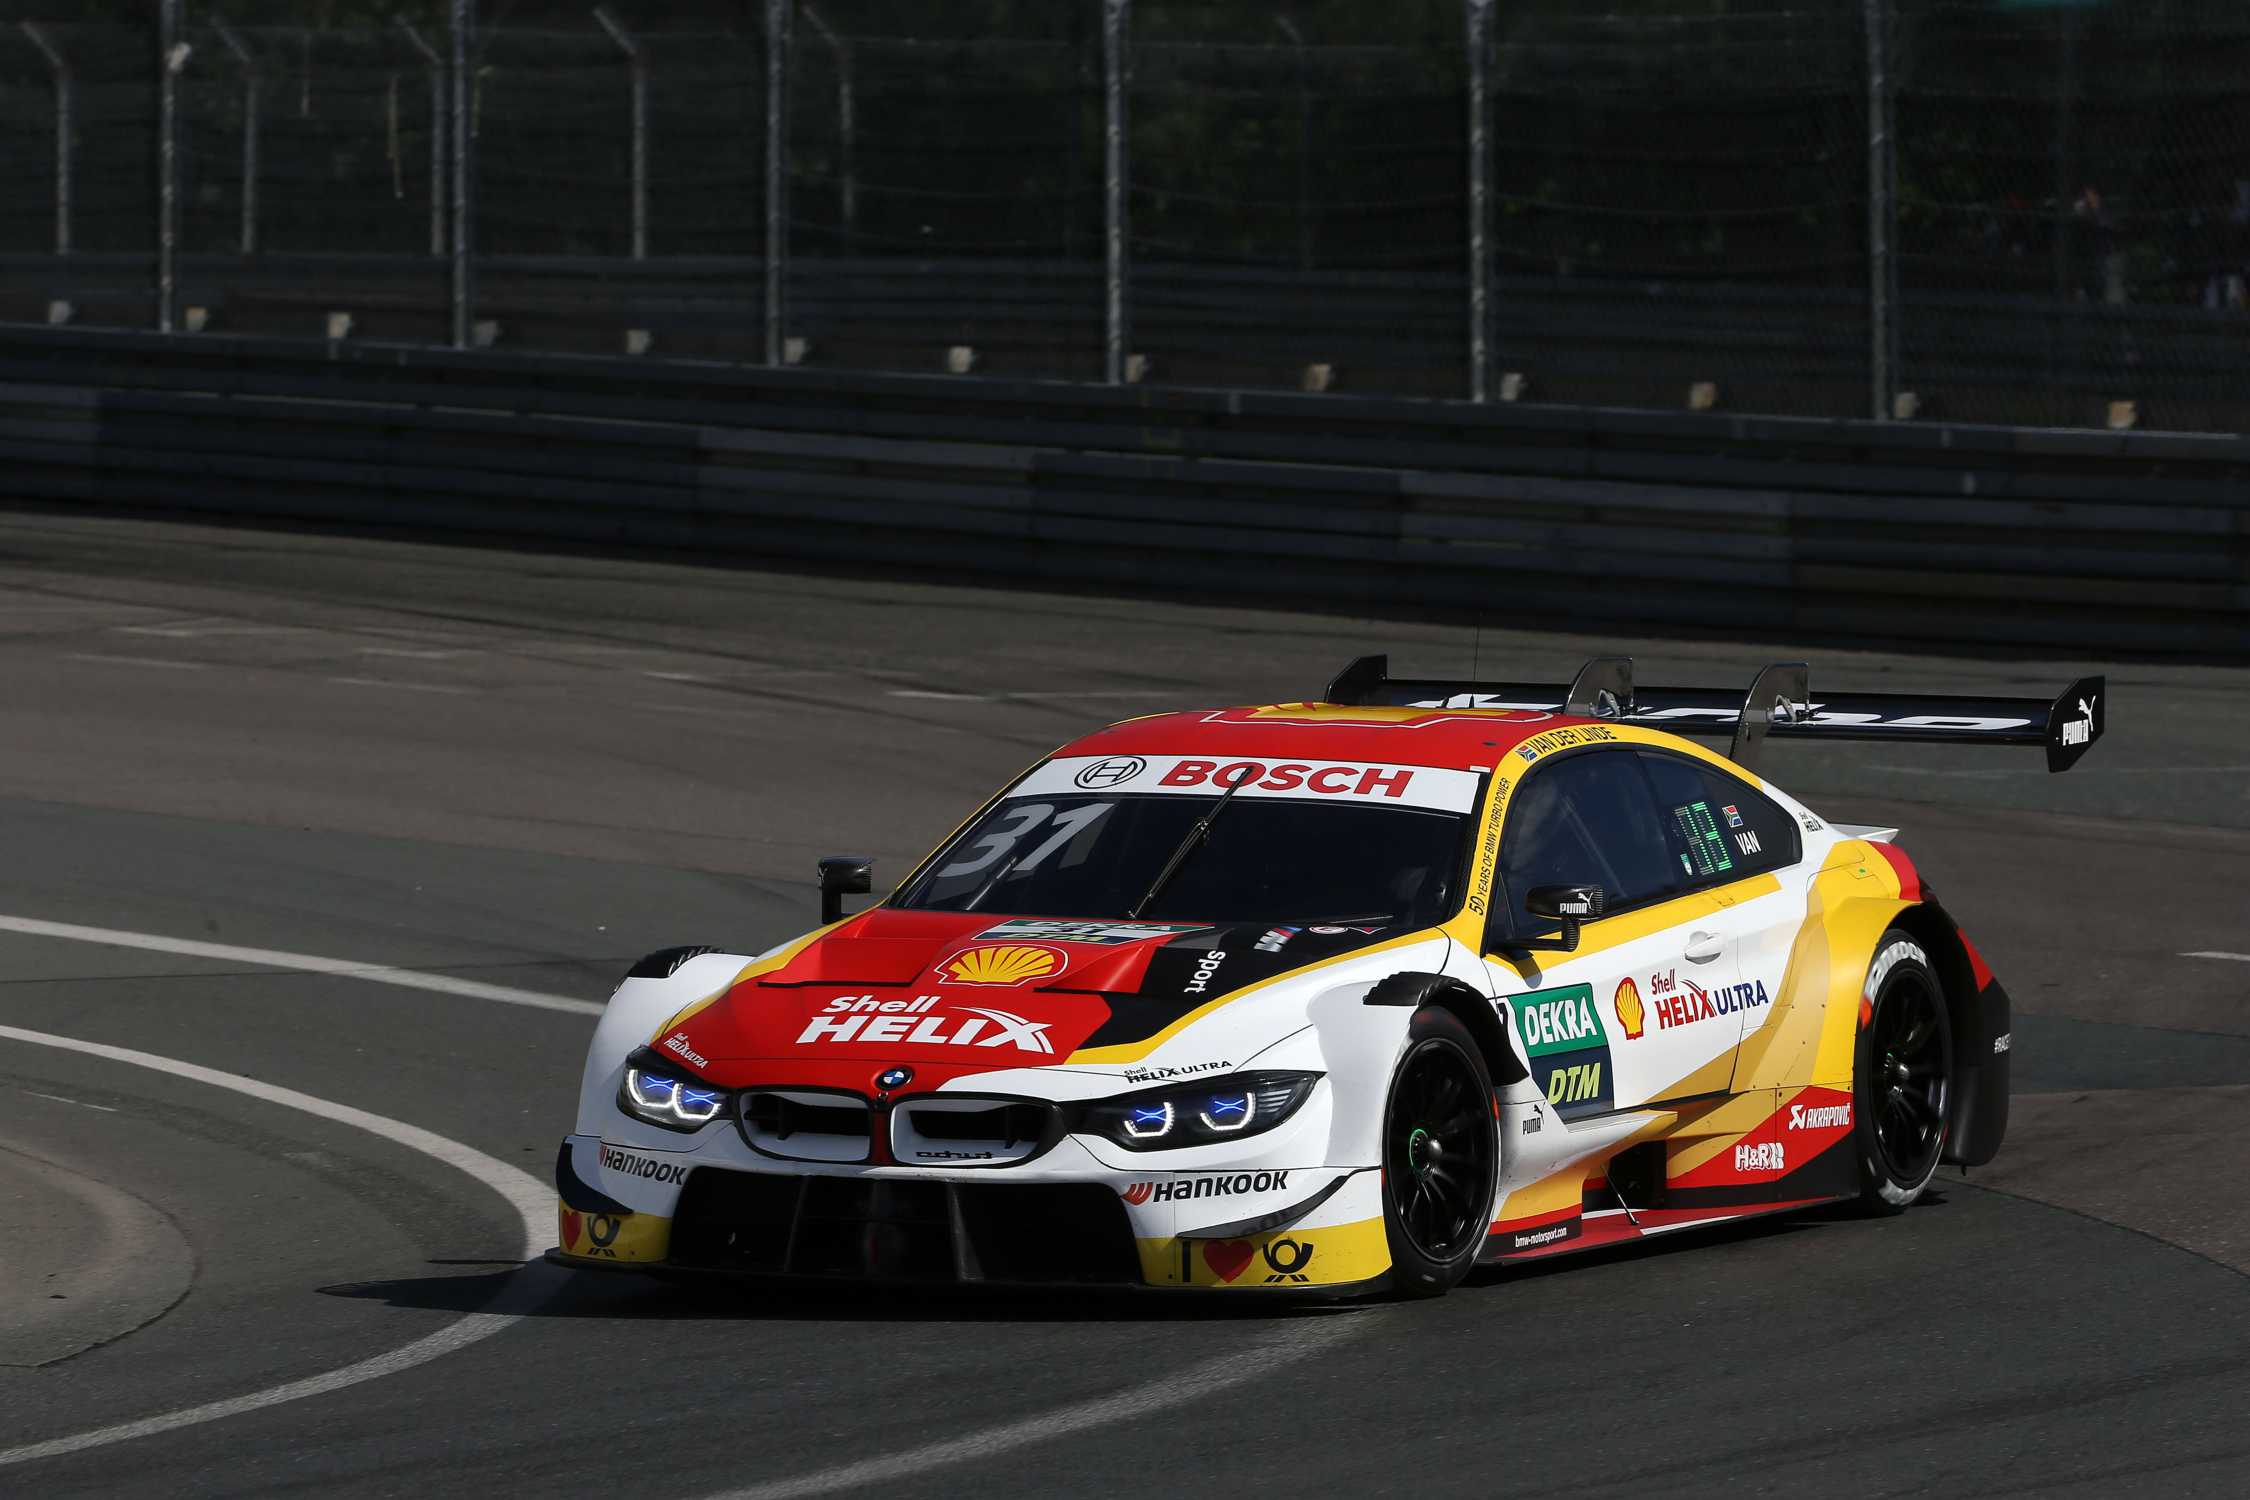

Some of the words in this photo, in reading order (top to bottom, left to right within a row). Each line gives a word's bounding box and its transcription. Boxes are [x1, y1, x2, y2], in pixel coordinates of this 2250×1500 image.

[1526, 735, 1557, 754] VAN
[1549, 730, 1582, 747] DER
[1580, 727, 1618, 742] LINDE
[2063, 719, 2089, 746] PUMA
[1157, 760, 1415, 798] BOSCH
[1494, 777, 1511, 802] POWER
[1489, 803, 1504, 831] TURBO
[936, 803, 1115, 878] 31
[1485, 830, 1498, 854] BMW
[1735, 830, 1762, 856] VAN
[1483, 853, 1493, 867] OF
[1477, 867, 1491, 897] YEARS
[1469, 896, 1486, 916] 50
[1559, 902, 1587, 914] PUMA
[1184, 950, 1226, 993] sport
[1651, 968, 1676, 995] Shell
[821, 995, 942, 1013] Shell
[1654, 982, 1718, 1030] HELIX
[1714, 979, 1769, 1016] ULTRA
[796, 1006, 1055, 1055] HELIX
[1524, 996, 1598, 1046] DEKRA
[684, 1050, 708, 1069] ULTRA
[1124, 1066, 1147, 1075] Shell
[1126, 1068, 1181, 1083] HELIX
[1181, 1061, 1232, 1074] ULTRA
[1547, 1062, 1601, 1105] DTM
[1523, 1117, 1541, 1135] PUMA
[1515, 1227, 1567, 1247] bmw-motorsport.com
